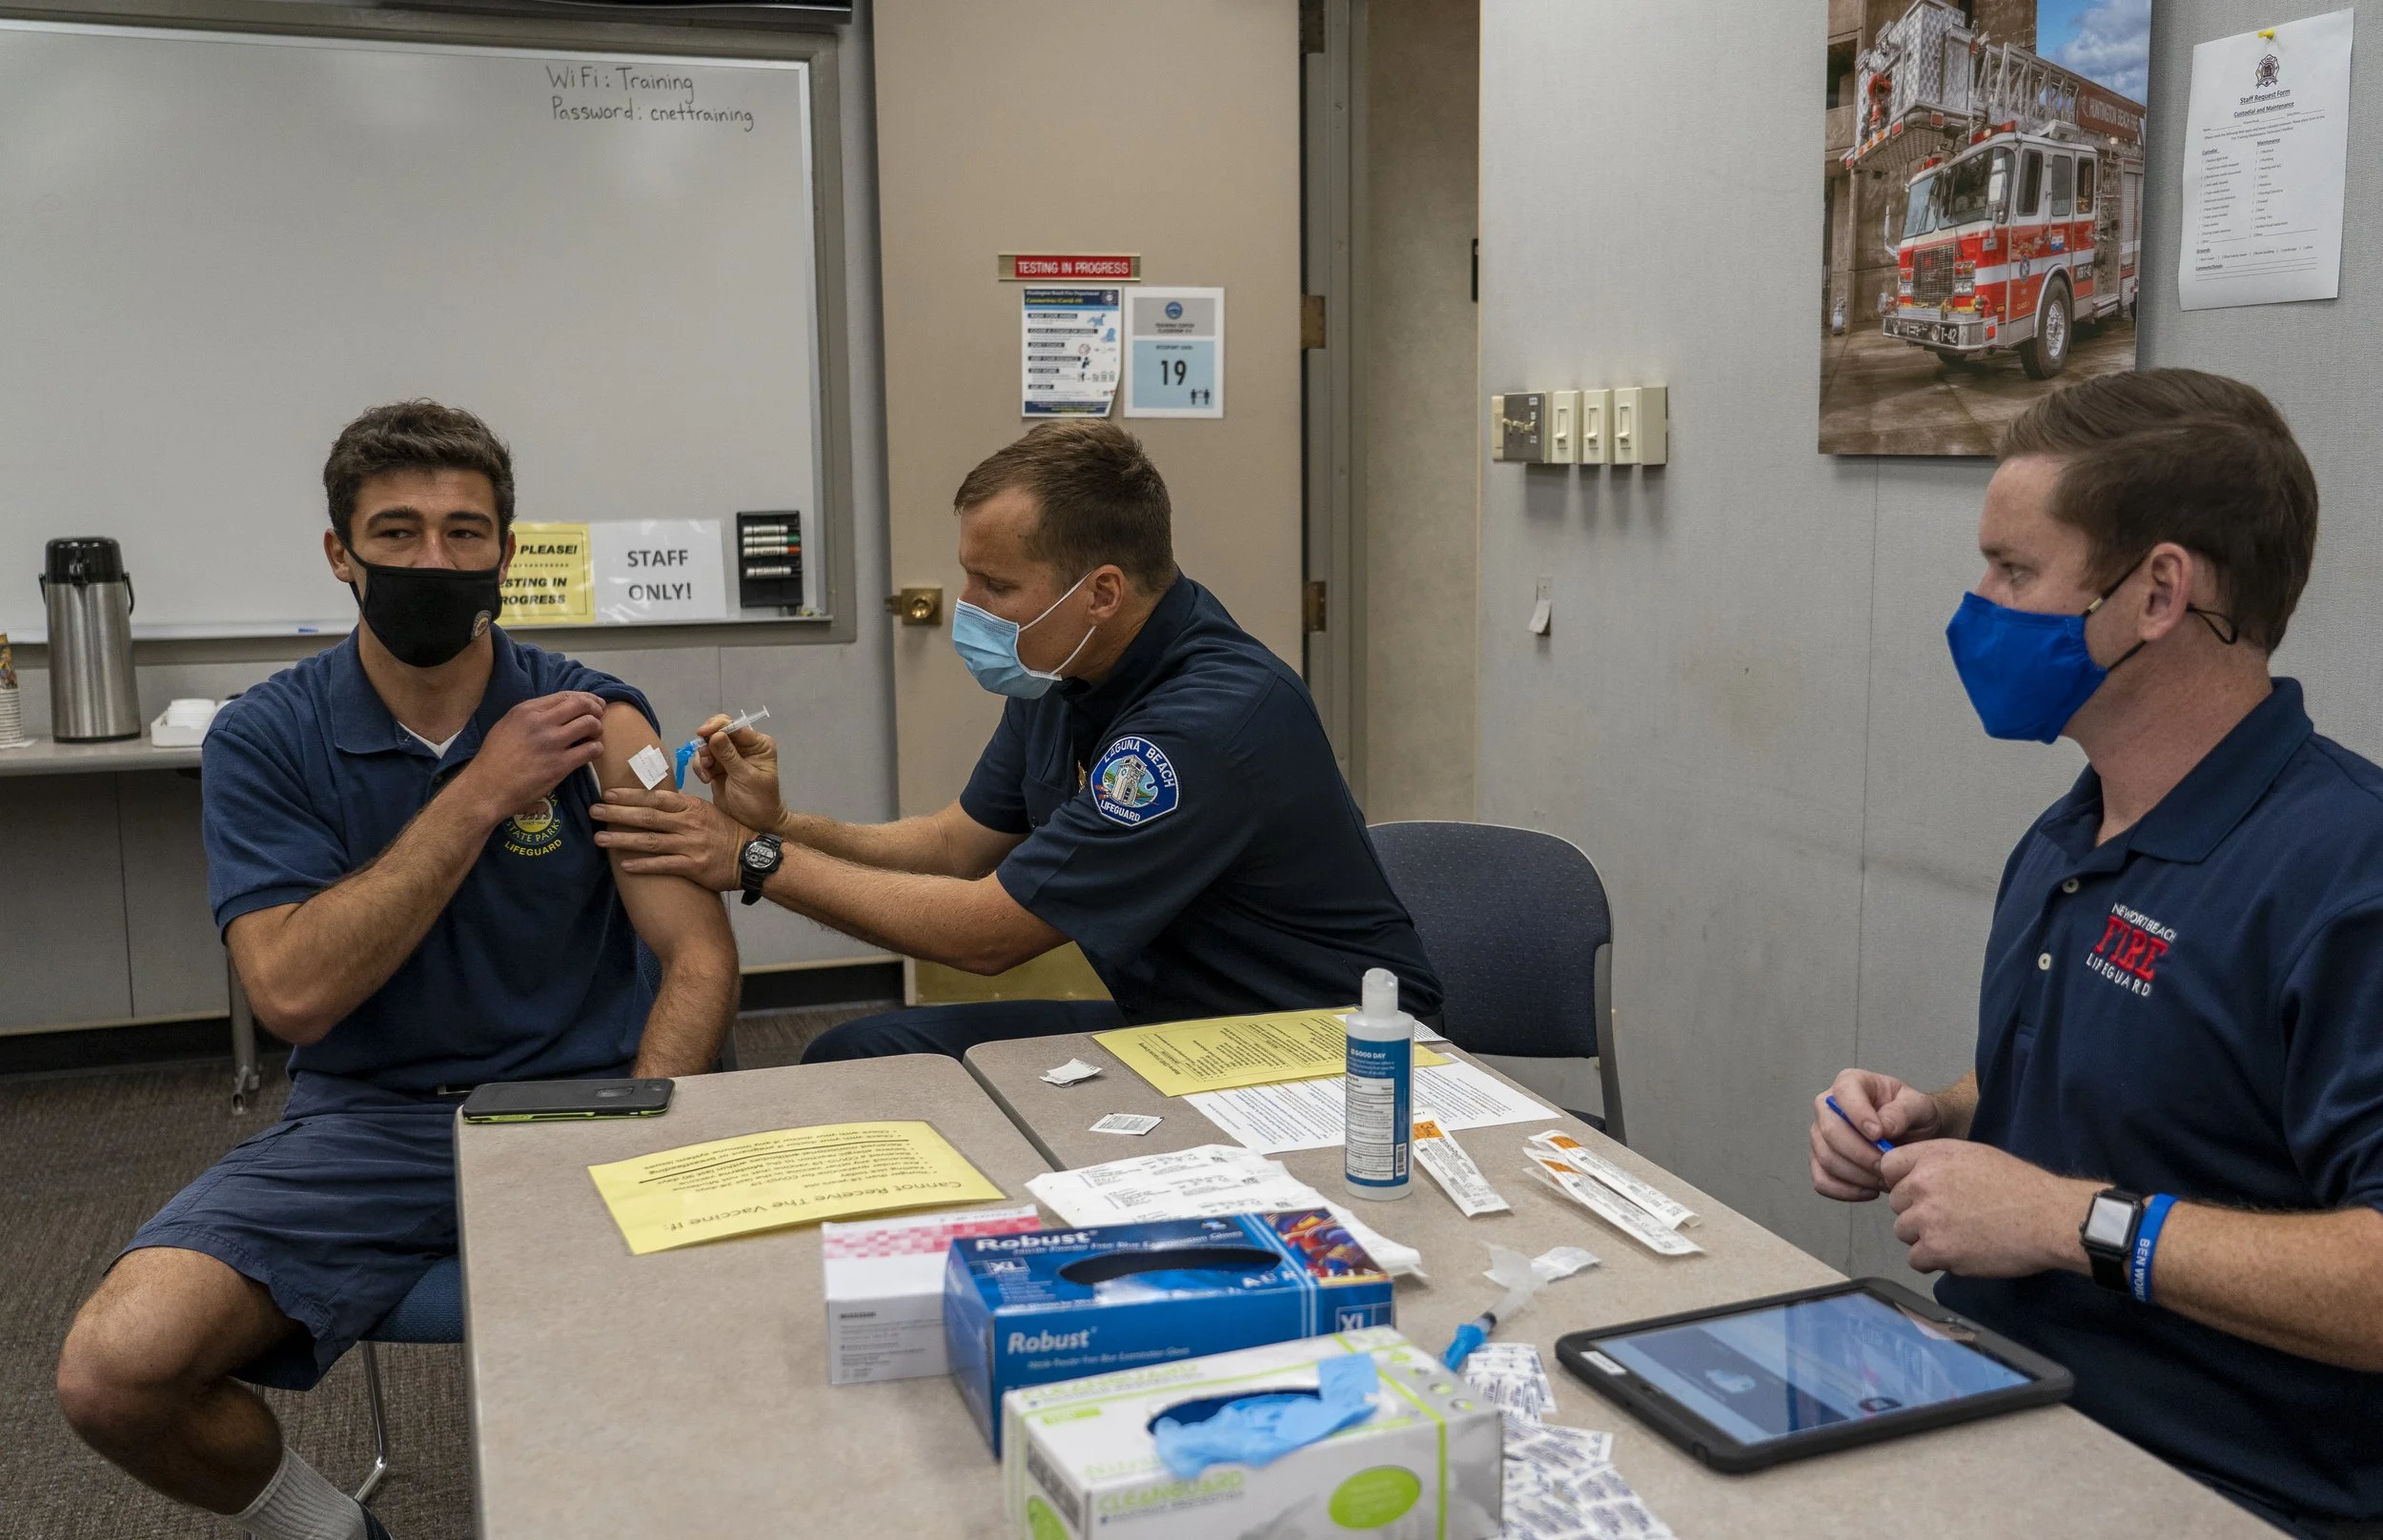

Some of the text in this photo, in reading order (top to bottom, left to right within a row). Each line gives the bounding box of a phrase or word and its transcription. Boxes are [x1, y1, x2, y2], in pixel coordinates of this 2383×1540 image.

[545, 65, 695, 105] WiFi: Training
[2240, 95, 2253, 105] Staff
[2254, 92, 2276, 102] Request
[551, 95, 755, 132] Password: cnettraining
[2234, 109, 2256, 118] Custodial
[2266, 102, 2294, 111] Maintenance
[1017, 261, 1129, 274] TESTING IN PROGRESS
[1161, 360, 1187, 385] 19
[520, 545, 578, 555] PLEASE!
[627, 549, 688, 568] STAFF
[500, 578, 567, 587] STING IN
[628, 582, 692, 602] ONLY!
[501, 595, 566, 604] ROGRESS
[1104, 740, 1175, 788] LAGUNA BEACH
[1100, 800, 1141, 821] LIFEGUARD
[505, 818, 560, 842] STATE PARKS
[505, 839, 562, 856] LIFEGUARD
[2094, 915, 2169, 982] FIRE
[2086, 952, 2152, 997] LIFEGUARD
[732, 1145, 774, 1155] pregnant
[649, 1157, 716, 1174] breastfeeding
[717, 1161, 747, 1170] within
[719, 1165, 763, 1176] Moderna
[663, 1182, 961, 1231] Cannot Receive The Vaccine If:
[976, 1230, 1090, 1252] Robust
[2135, 1238, 2151, 1266] BEN
[989, 1260, 1017, 1273] XL
[1007, 1329, 1090, 1355] Robust
